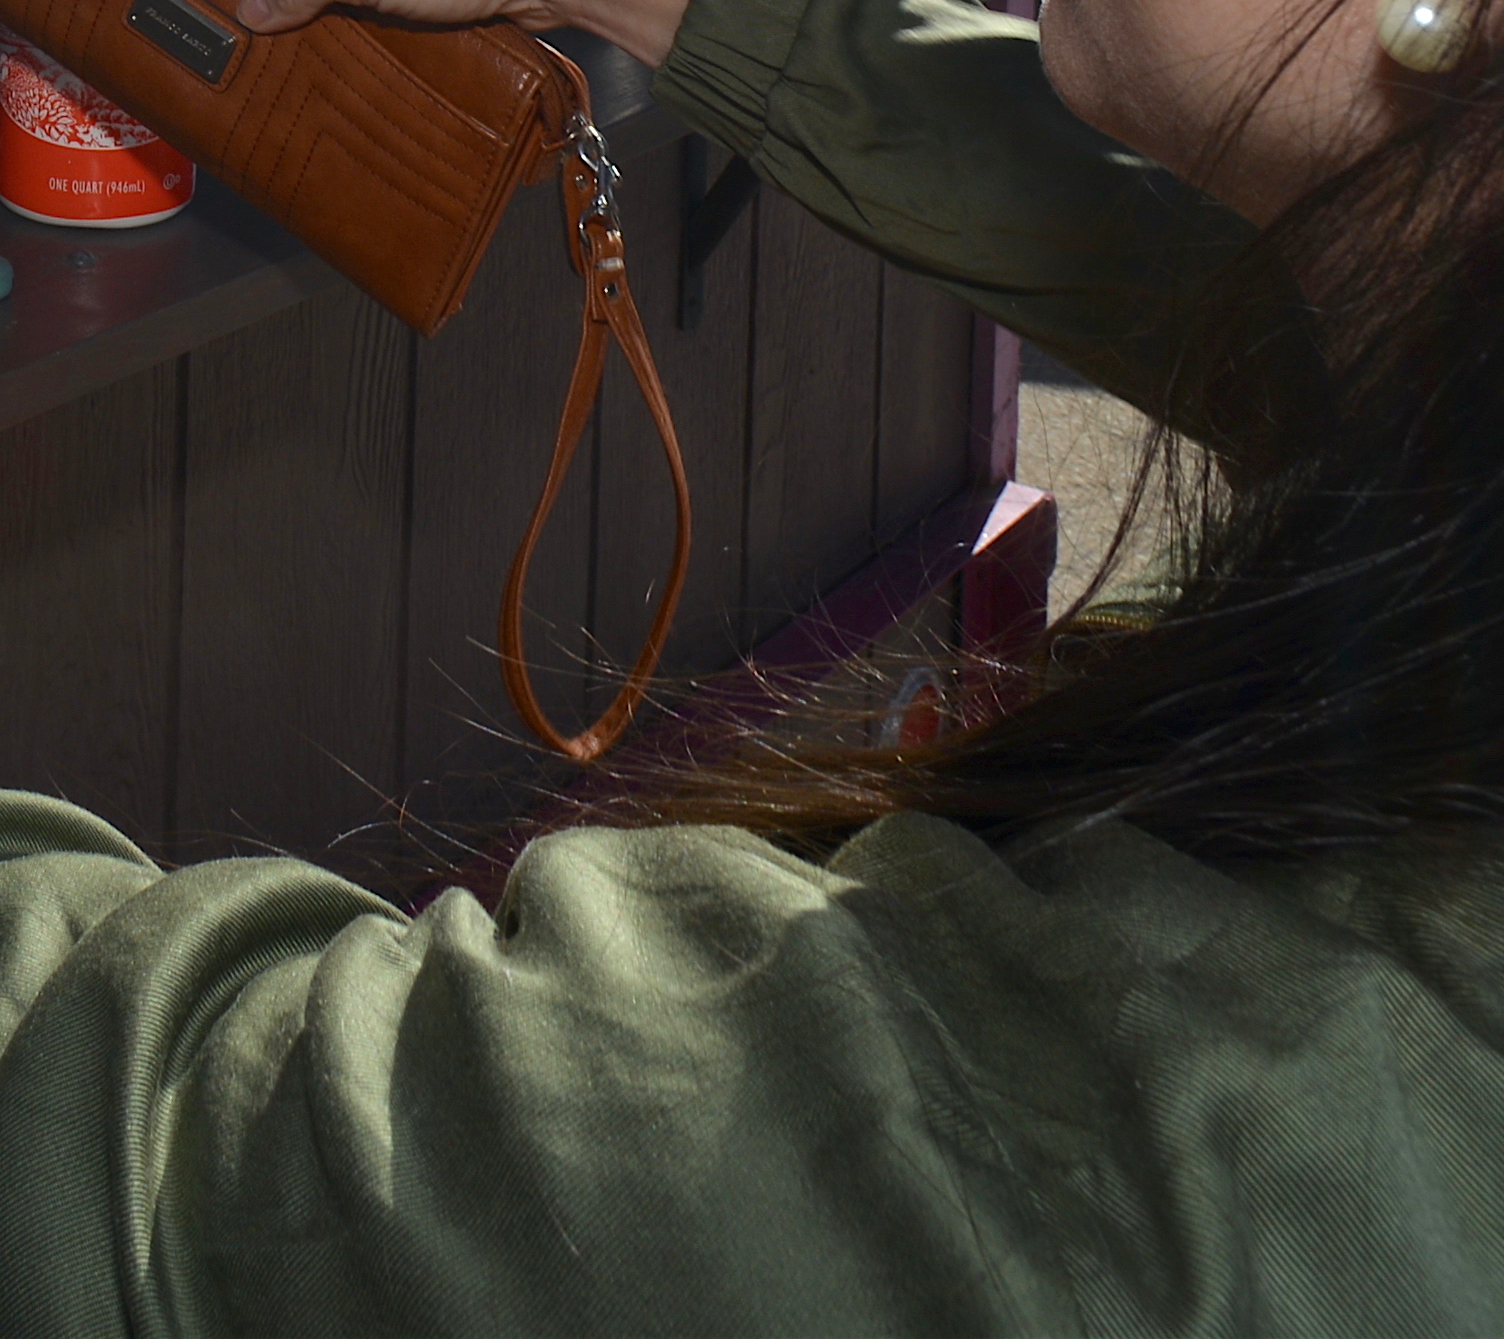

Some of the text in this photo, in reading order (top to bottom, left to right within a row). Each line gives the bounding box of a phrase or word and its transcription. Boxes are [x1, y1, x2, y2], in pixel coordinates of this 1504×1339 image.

[48, 176, 146, 197] ONE QUART (946mL)
